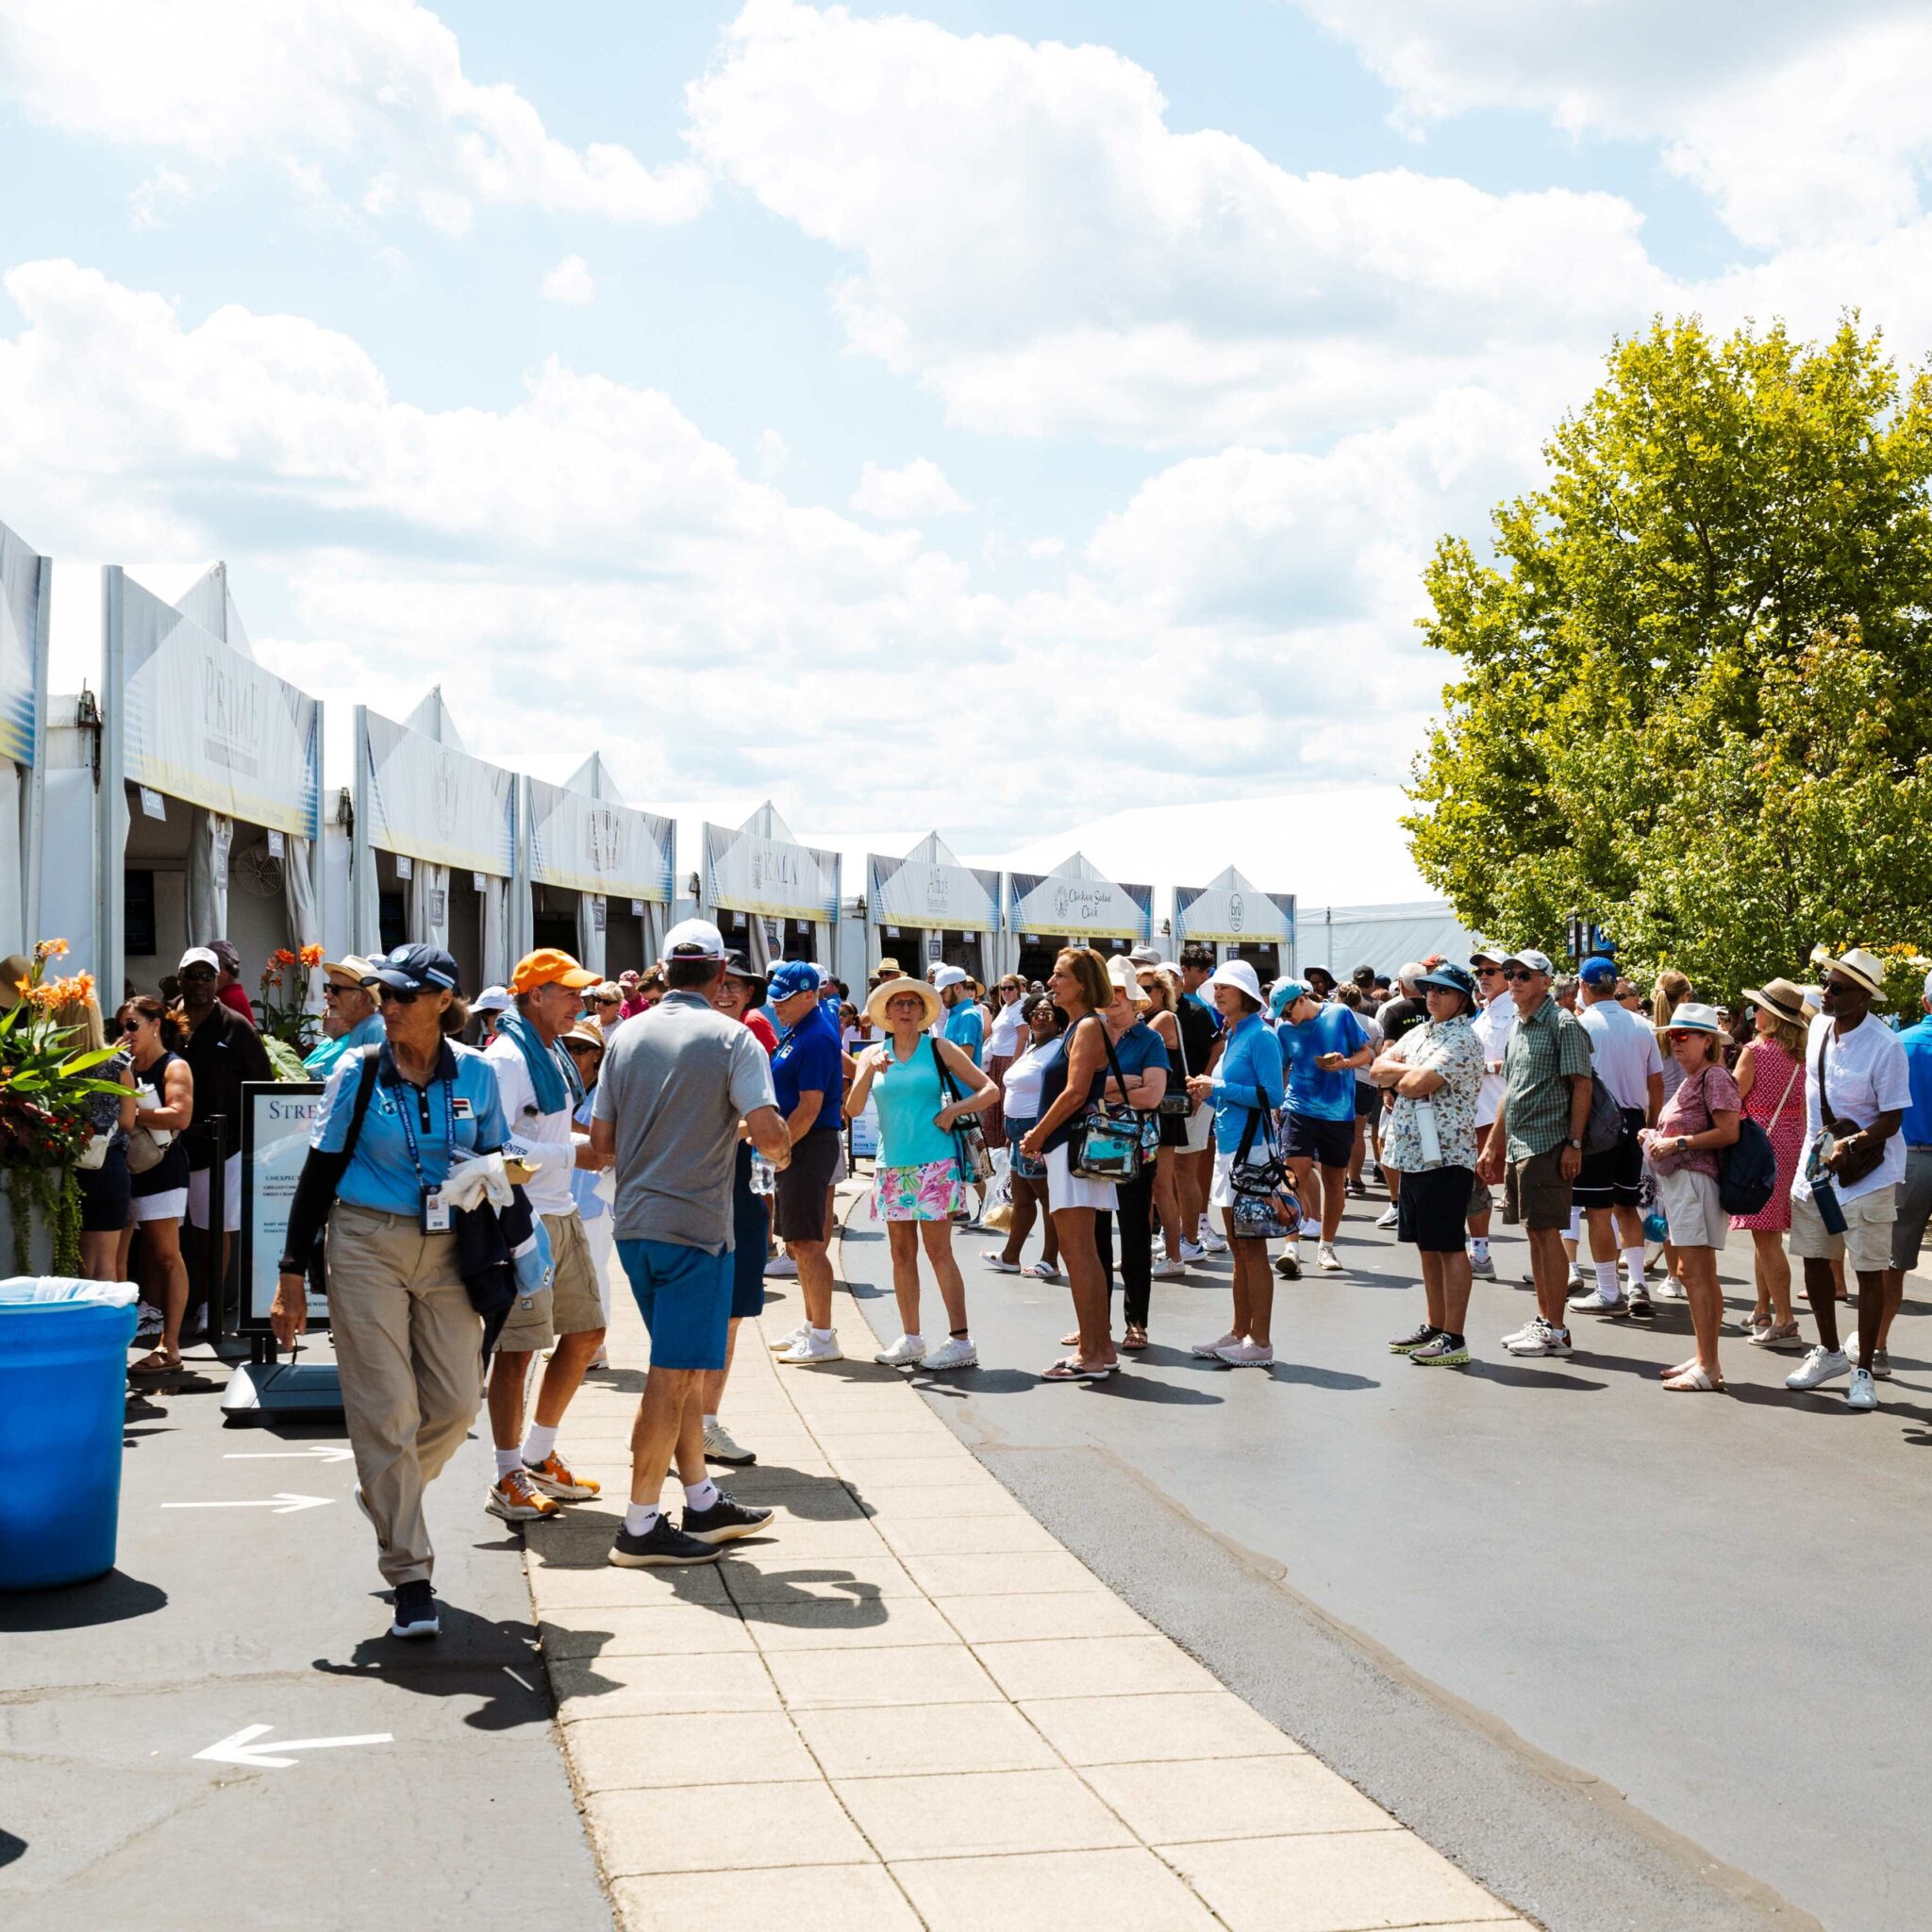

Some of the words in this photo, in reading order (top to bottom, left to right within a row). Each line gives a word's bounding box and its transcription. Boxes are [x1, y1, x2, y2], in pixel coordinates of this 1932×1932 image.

[204, 655, 258, 746] PRIME
[1068, 889, 1093, 903] Chicken
[1094, 890, 1111, 906] Salad
[1081, 905, 1098, 919] Chick
